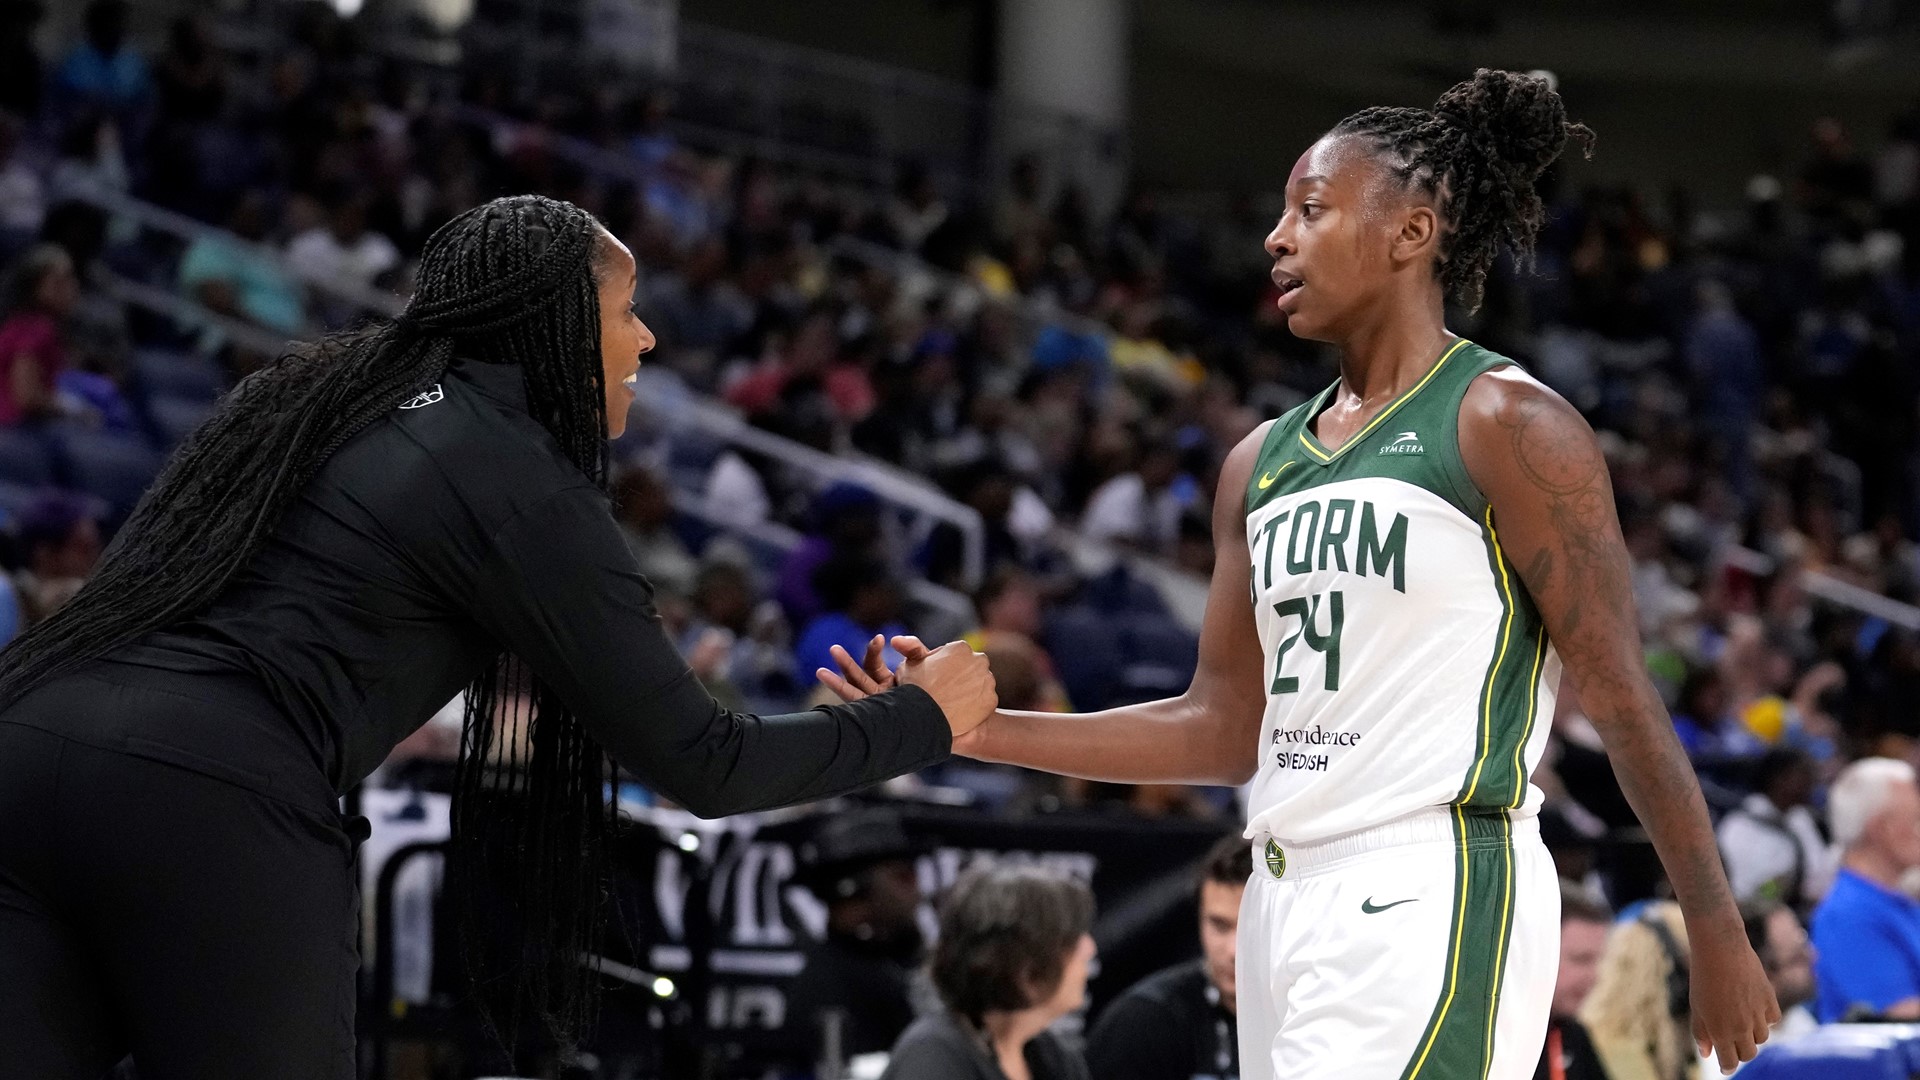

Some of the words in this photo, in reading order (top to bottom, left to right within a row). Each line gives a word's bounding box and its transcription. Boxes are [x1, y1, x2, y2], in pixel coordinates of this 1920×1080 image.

[1379, 444, 1424, 455] SYMETRA
[1270, 591, 1344, 694] 24
[1274, 724, 1361, 746] Proidence
